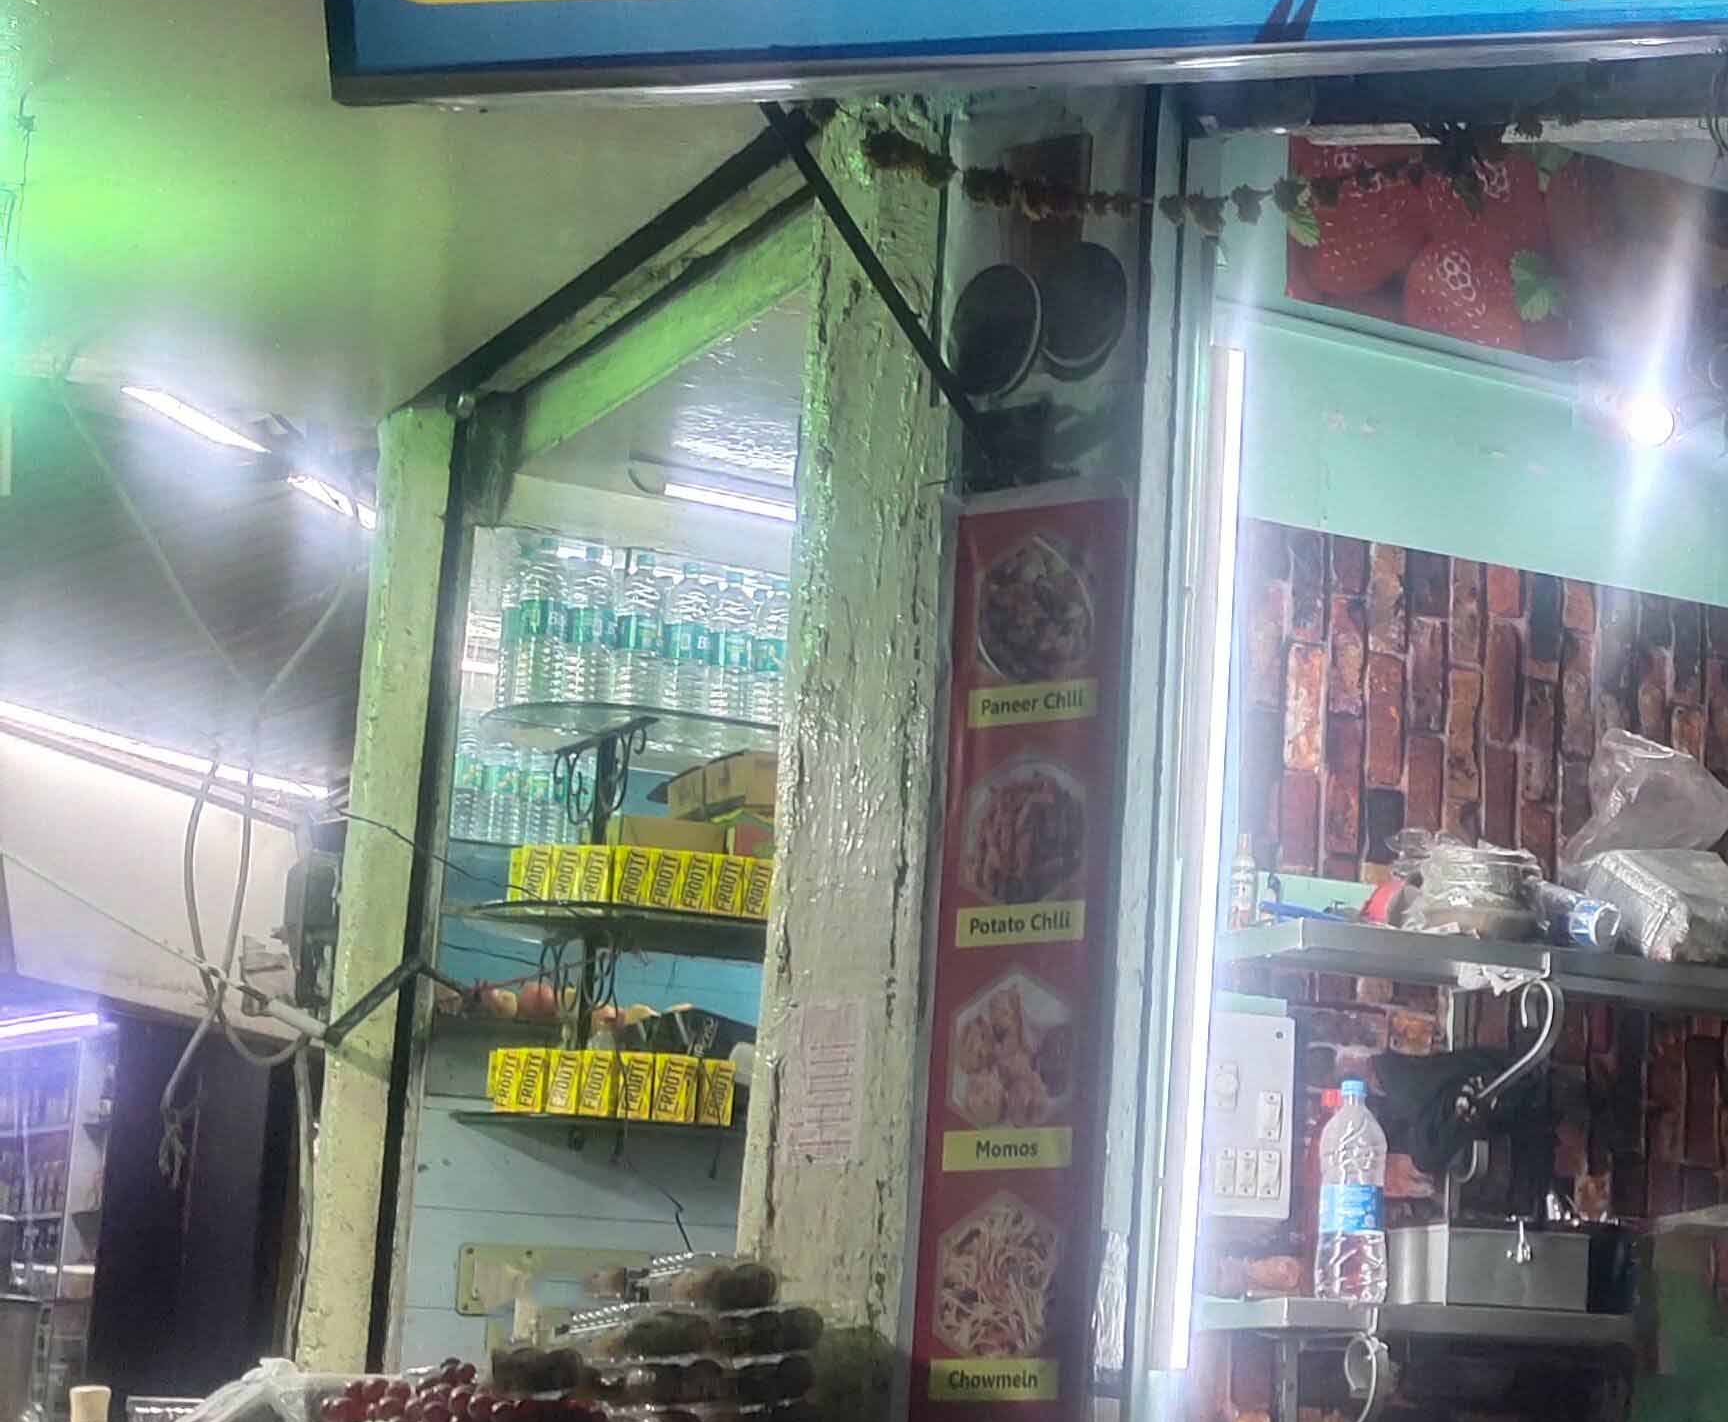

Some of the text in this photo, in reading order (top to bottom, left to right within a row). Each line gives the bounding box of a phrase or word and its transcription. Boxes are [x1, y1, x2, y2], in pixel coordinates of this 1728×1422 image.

[981, 698, 1039, 715] Paneer
[524, 849, 549, 900] ROOTI
[554, 849, 578, 900] ROOTI
[582, 850, 606, 901] ROOTI
[969, 915, 1025, 936] Potato
[975, 1139, 1039, 1159] Momos
[948, 1369, 1039, 1390] Chowmein
